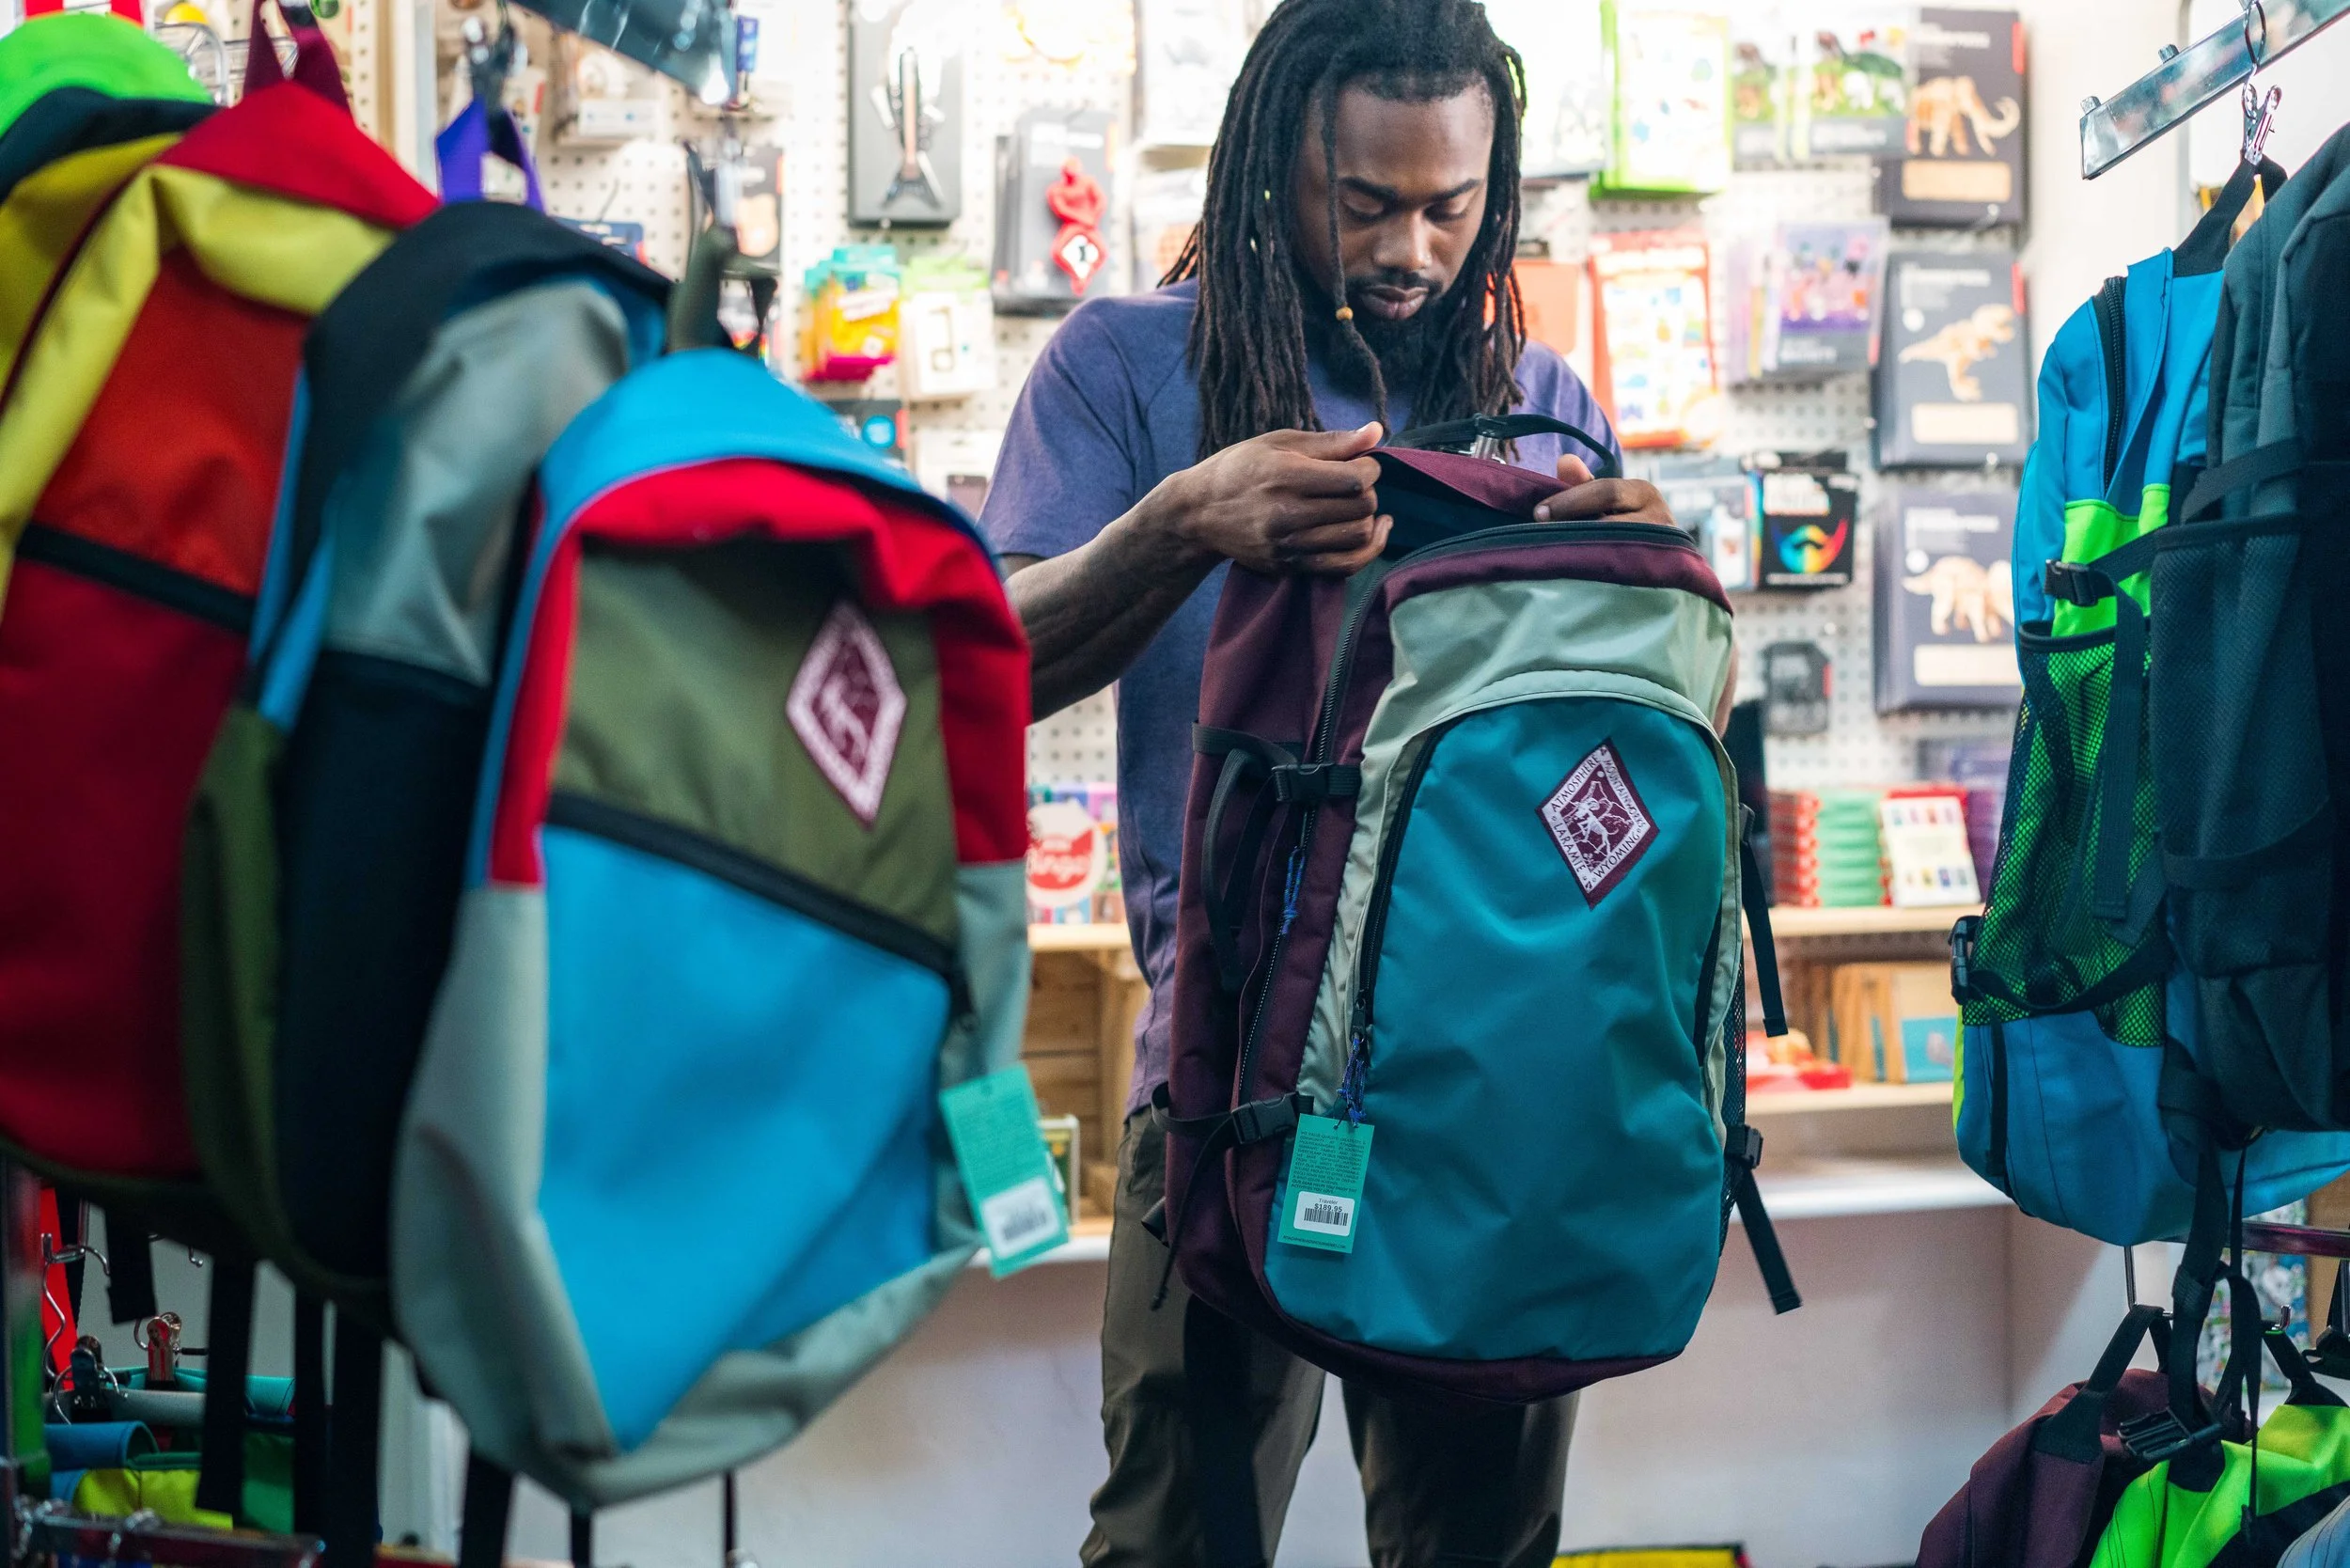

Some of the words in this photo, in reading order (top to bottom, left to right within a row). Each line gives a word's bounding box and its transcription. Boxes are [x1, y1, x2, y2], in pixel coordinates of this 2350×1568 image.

[1551, 753, 1600, 813] ATMOSPHERE
[1603, 760, 1647, 830] MOUNTAINWORKS
[1553, 822, 1587, 873] LARAMIE
[1593, 833, 1641, 879] WYOMING
[1314, 1203, 1343, 1213] $189.95
